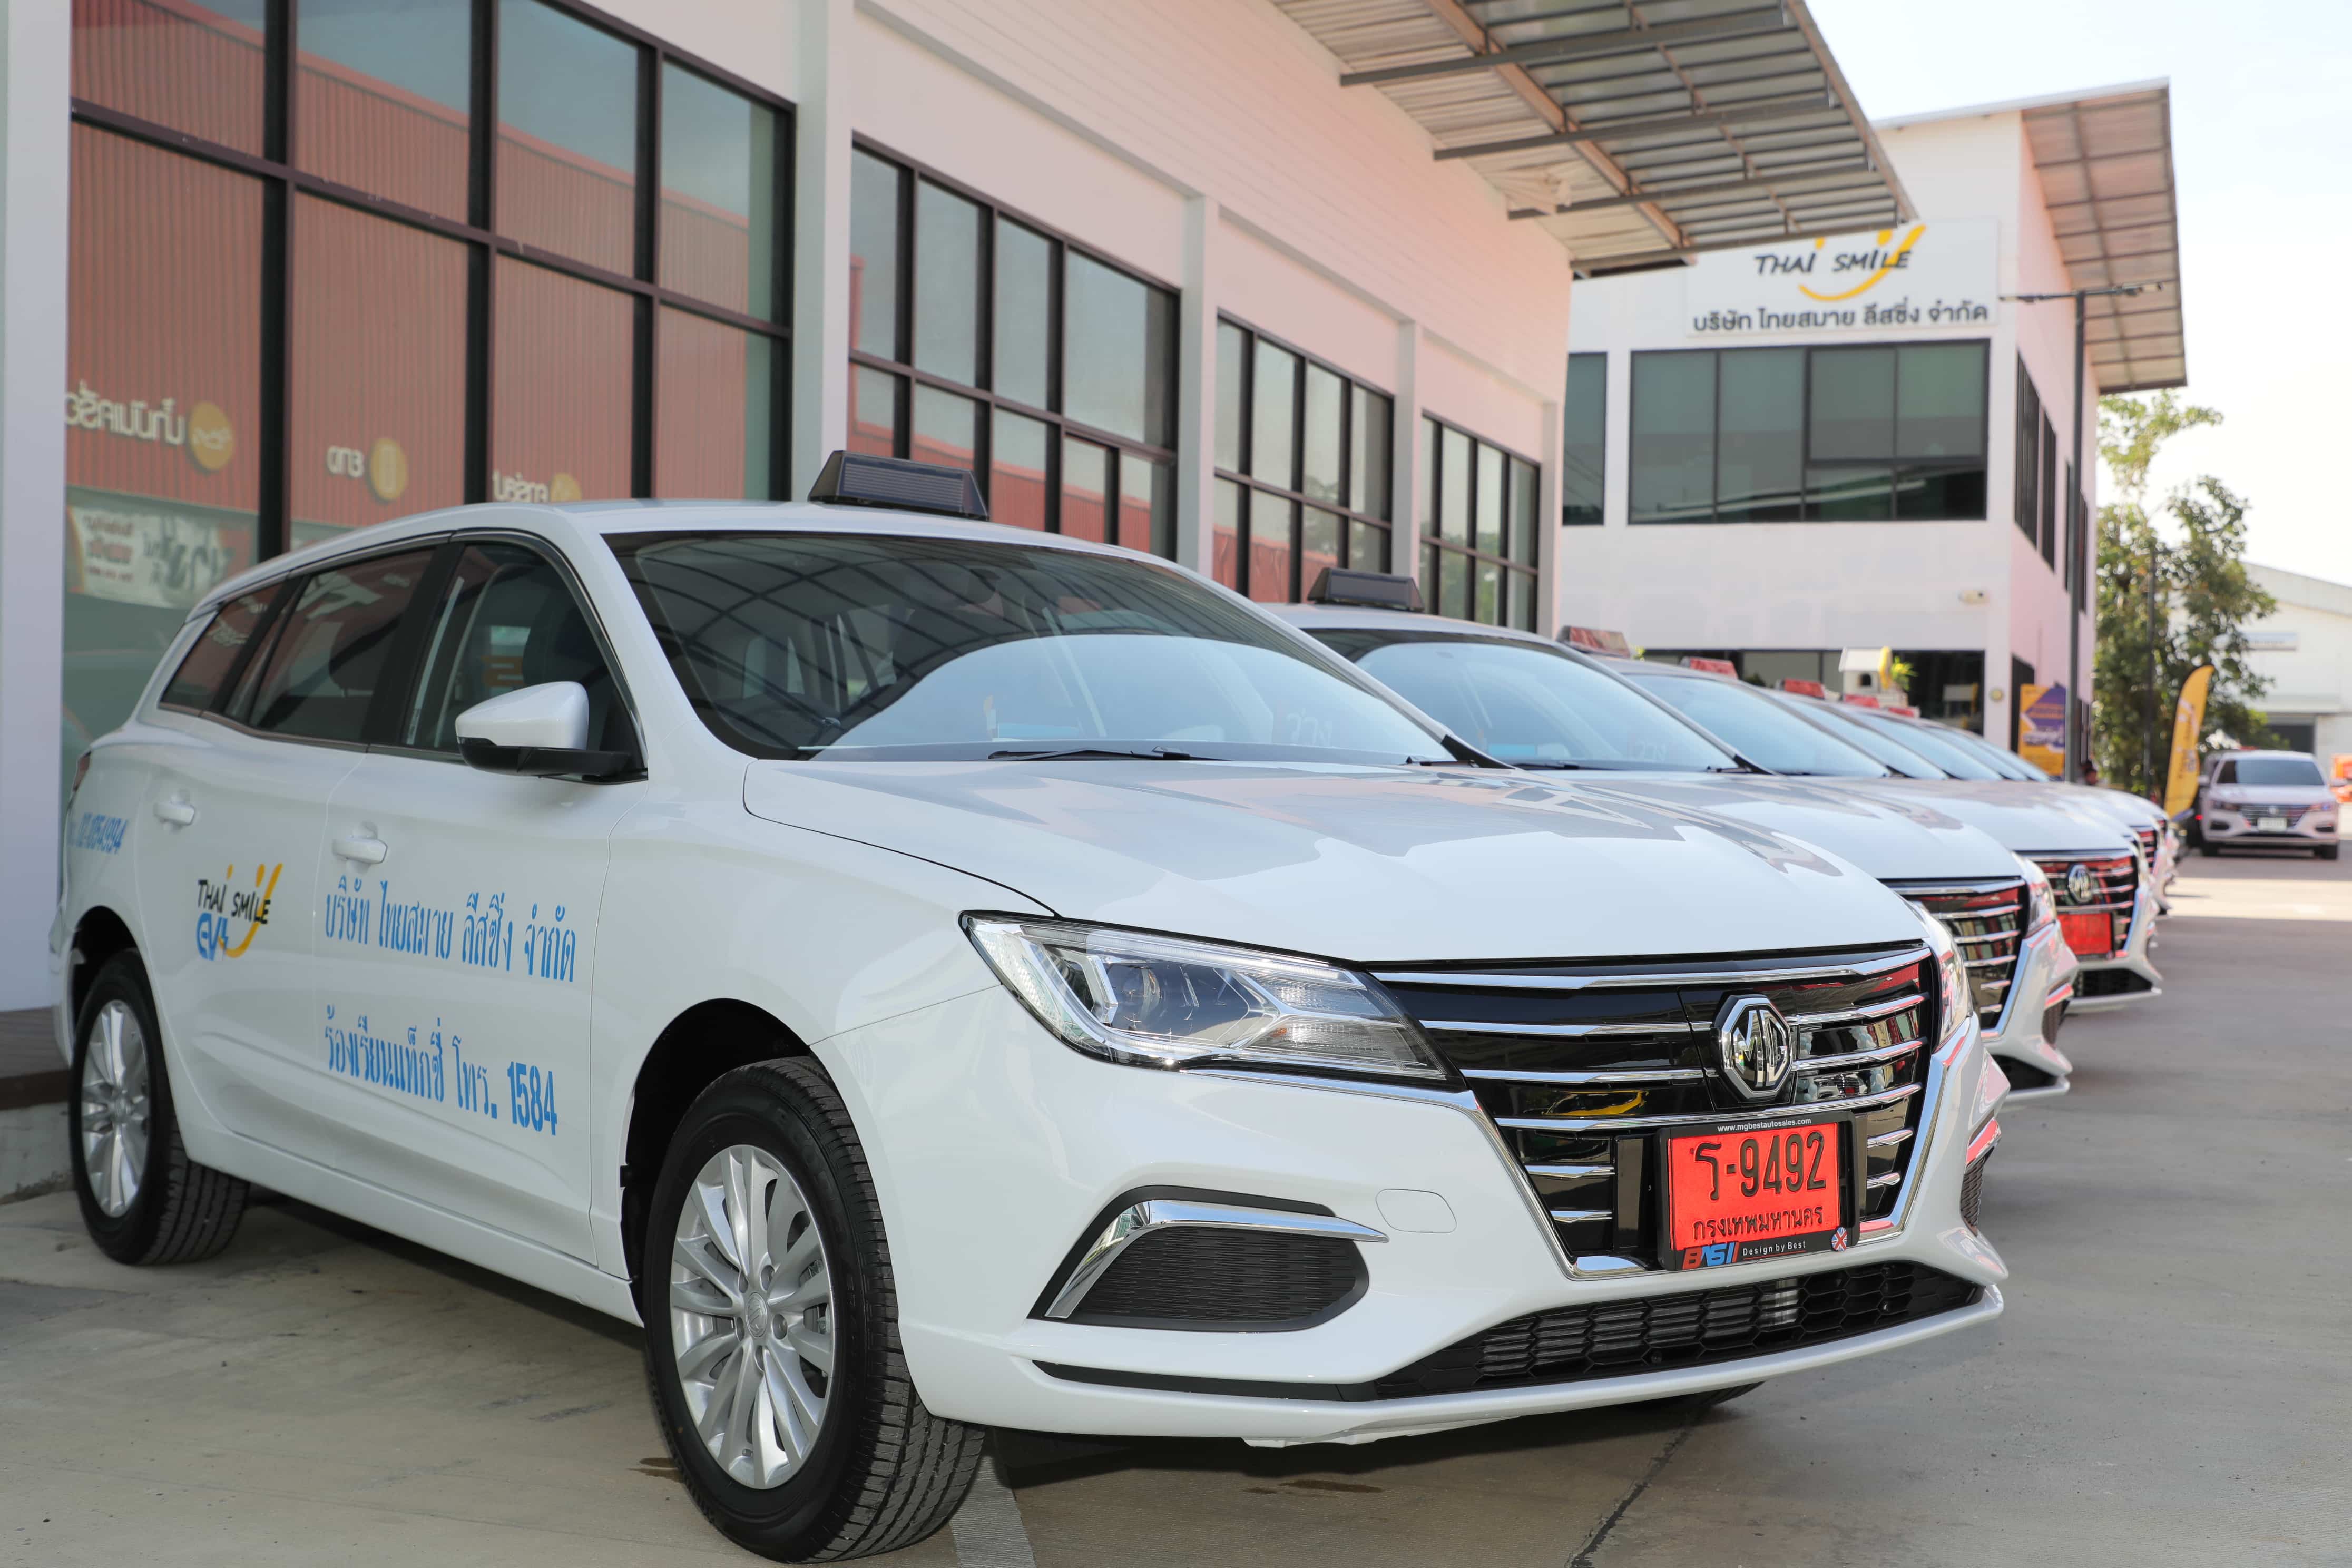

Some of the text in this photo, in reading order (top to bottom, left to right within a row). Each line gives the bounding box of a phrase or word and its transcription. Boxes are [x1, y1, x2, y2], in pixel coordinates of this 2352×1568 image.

[1754, 240, 1913, 275] THAI SMILE
[1694, 310, 1751, 331] บริษัท
[1757, 307, 1855, 330] ไทยสมาย
[1927, 299, 1988, 323] จำกัด
[197, 870, 271, 925] THAI SMILE
[325, 875, 576, 983] บริษัท ไทยสมาย ลีสซิ่ง จำกัด
[1733, 1010, 1788, 1087] MG
[325, 1004, 558, 1136] ร้องเรียนแท็กซี่ โทร. 1584
[1717, 1118, 1812, 1132] www.mgbestautosales.com
[1693, 1206, 1823, 1242] กรุงเทพมหานคร
[1742, 1241, 1806, 1256] Design by Best
